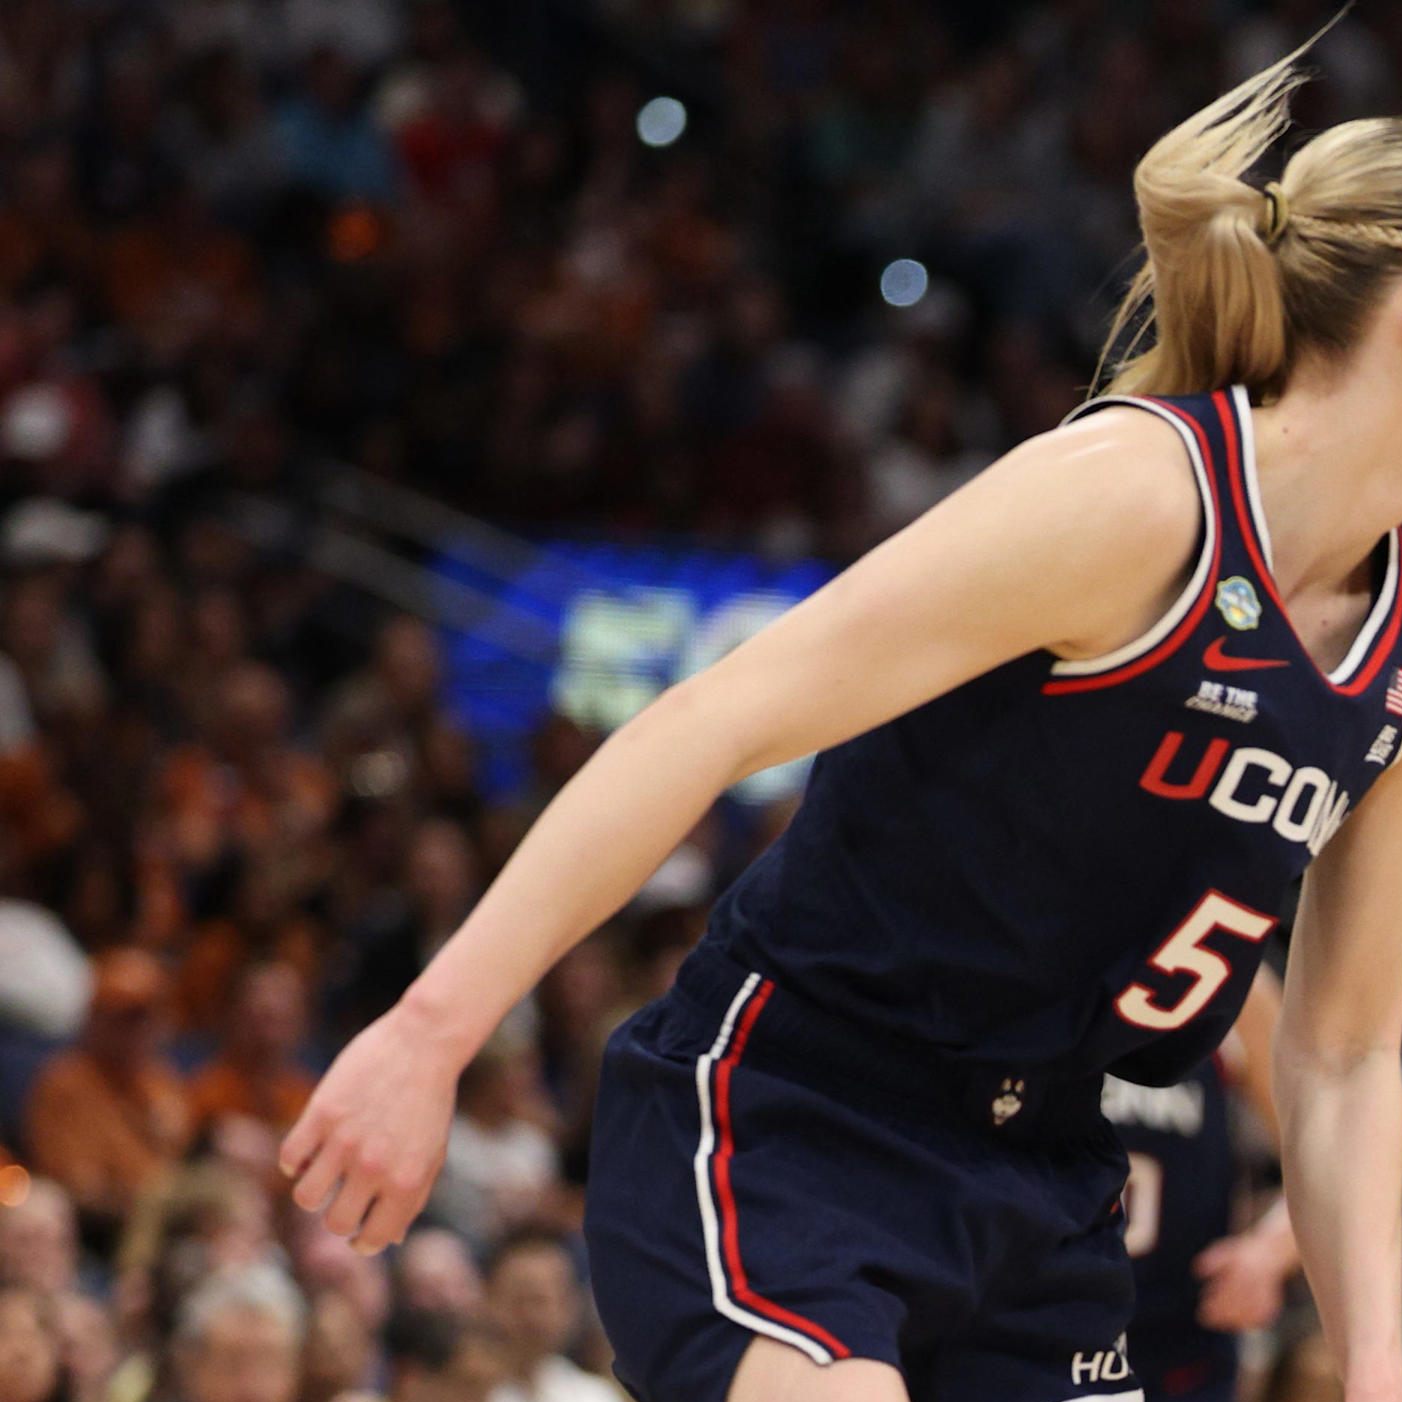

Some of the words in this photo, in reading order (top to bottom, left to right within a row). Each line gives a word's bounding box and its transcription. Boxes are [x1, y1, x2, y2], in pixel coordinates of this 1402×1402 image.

[1139, 731, 1351, 857] UCON
[1112, 888, 1280, 1032] 5
[1071, 1350, 1130, 1385] HU
